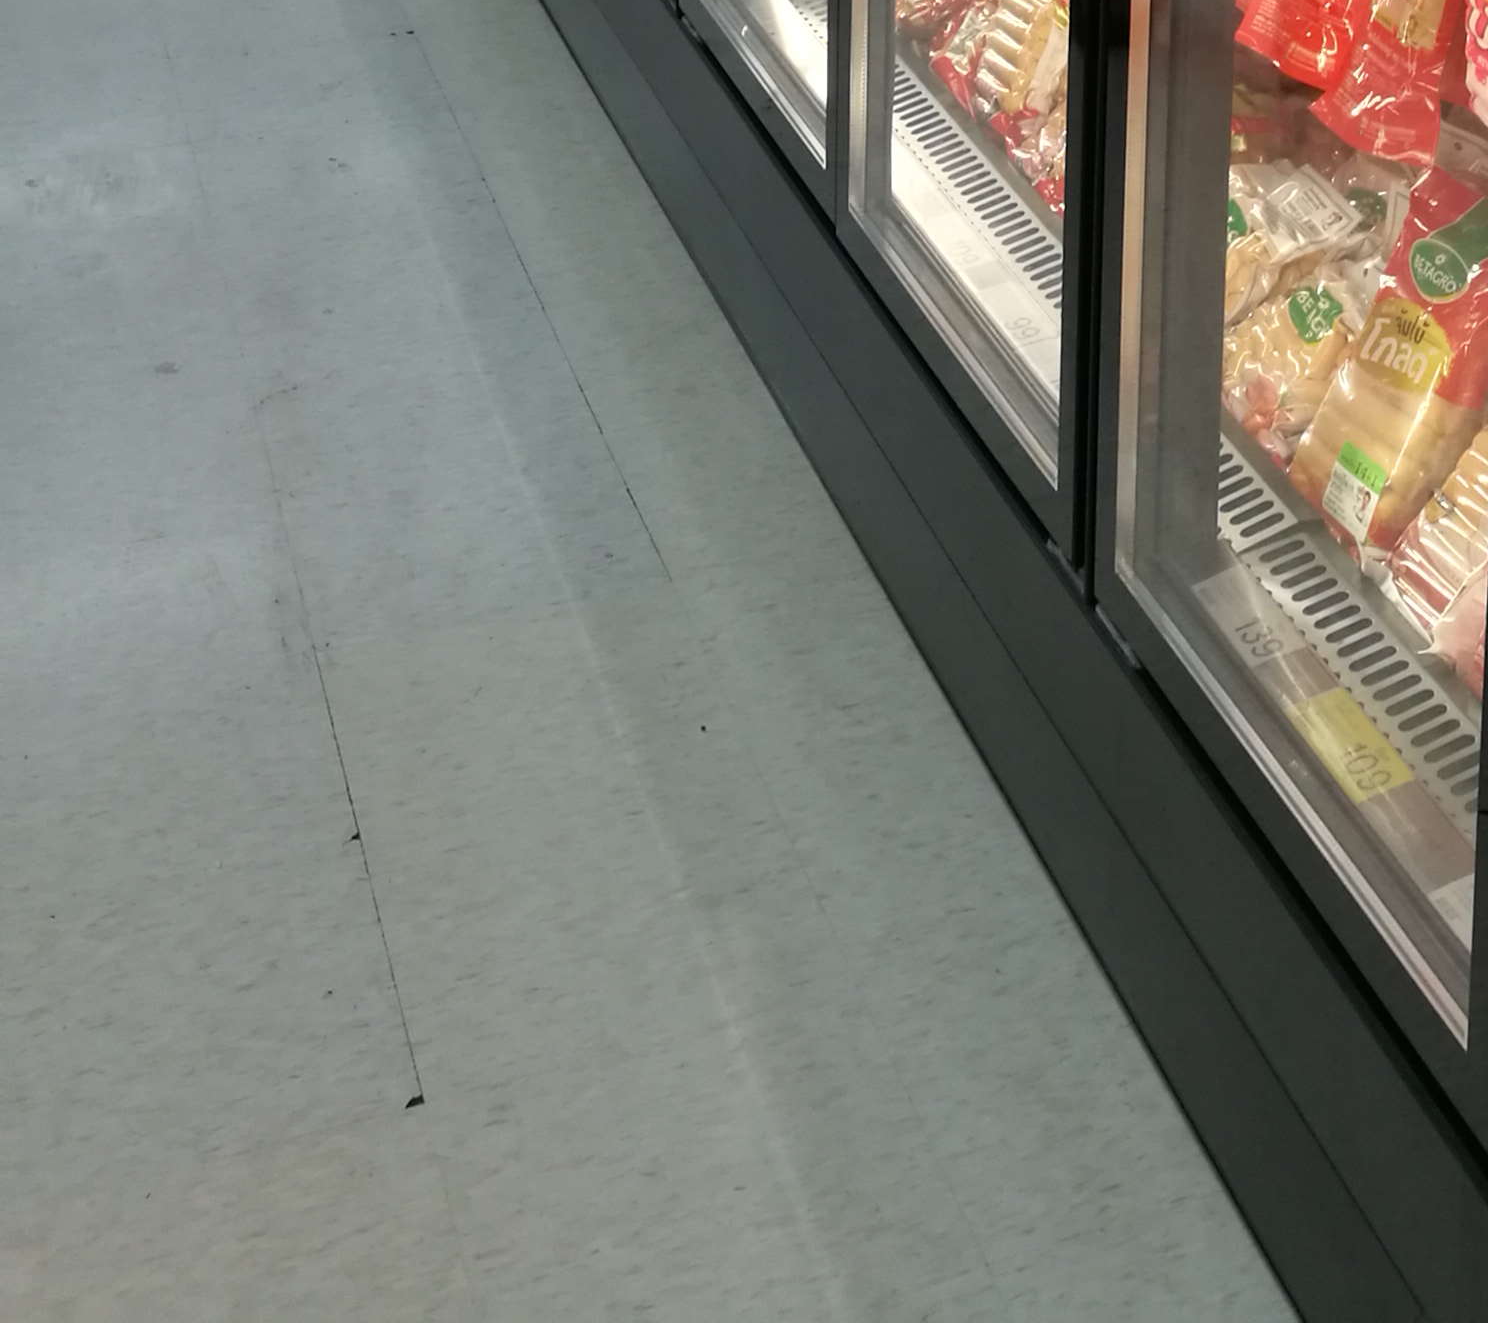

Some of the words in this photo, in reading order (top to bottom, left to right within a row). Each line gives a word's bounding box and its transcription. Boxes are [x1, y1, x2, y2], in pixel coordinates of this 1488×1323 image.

[1413, 253, 1457, 294] BETAGRO
[1234, 621, 1284, 657] 139
[1343, 742, 1392, 791] 109
